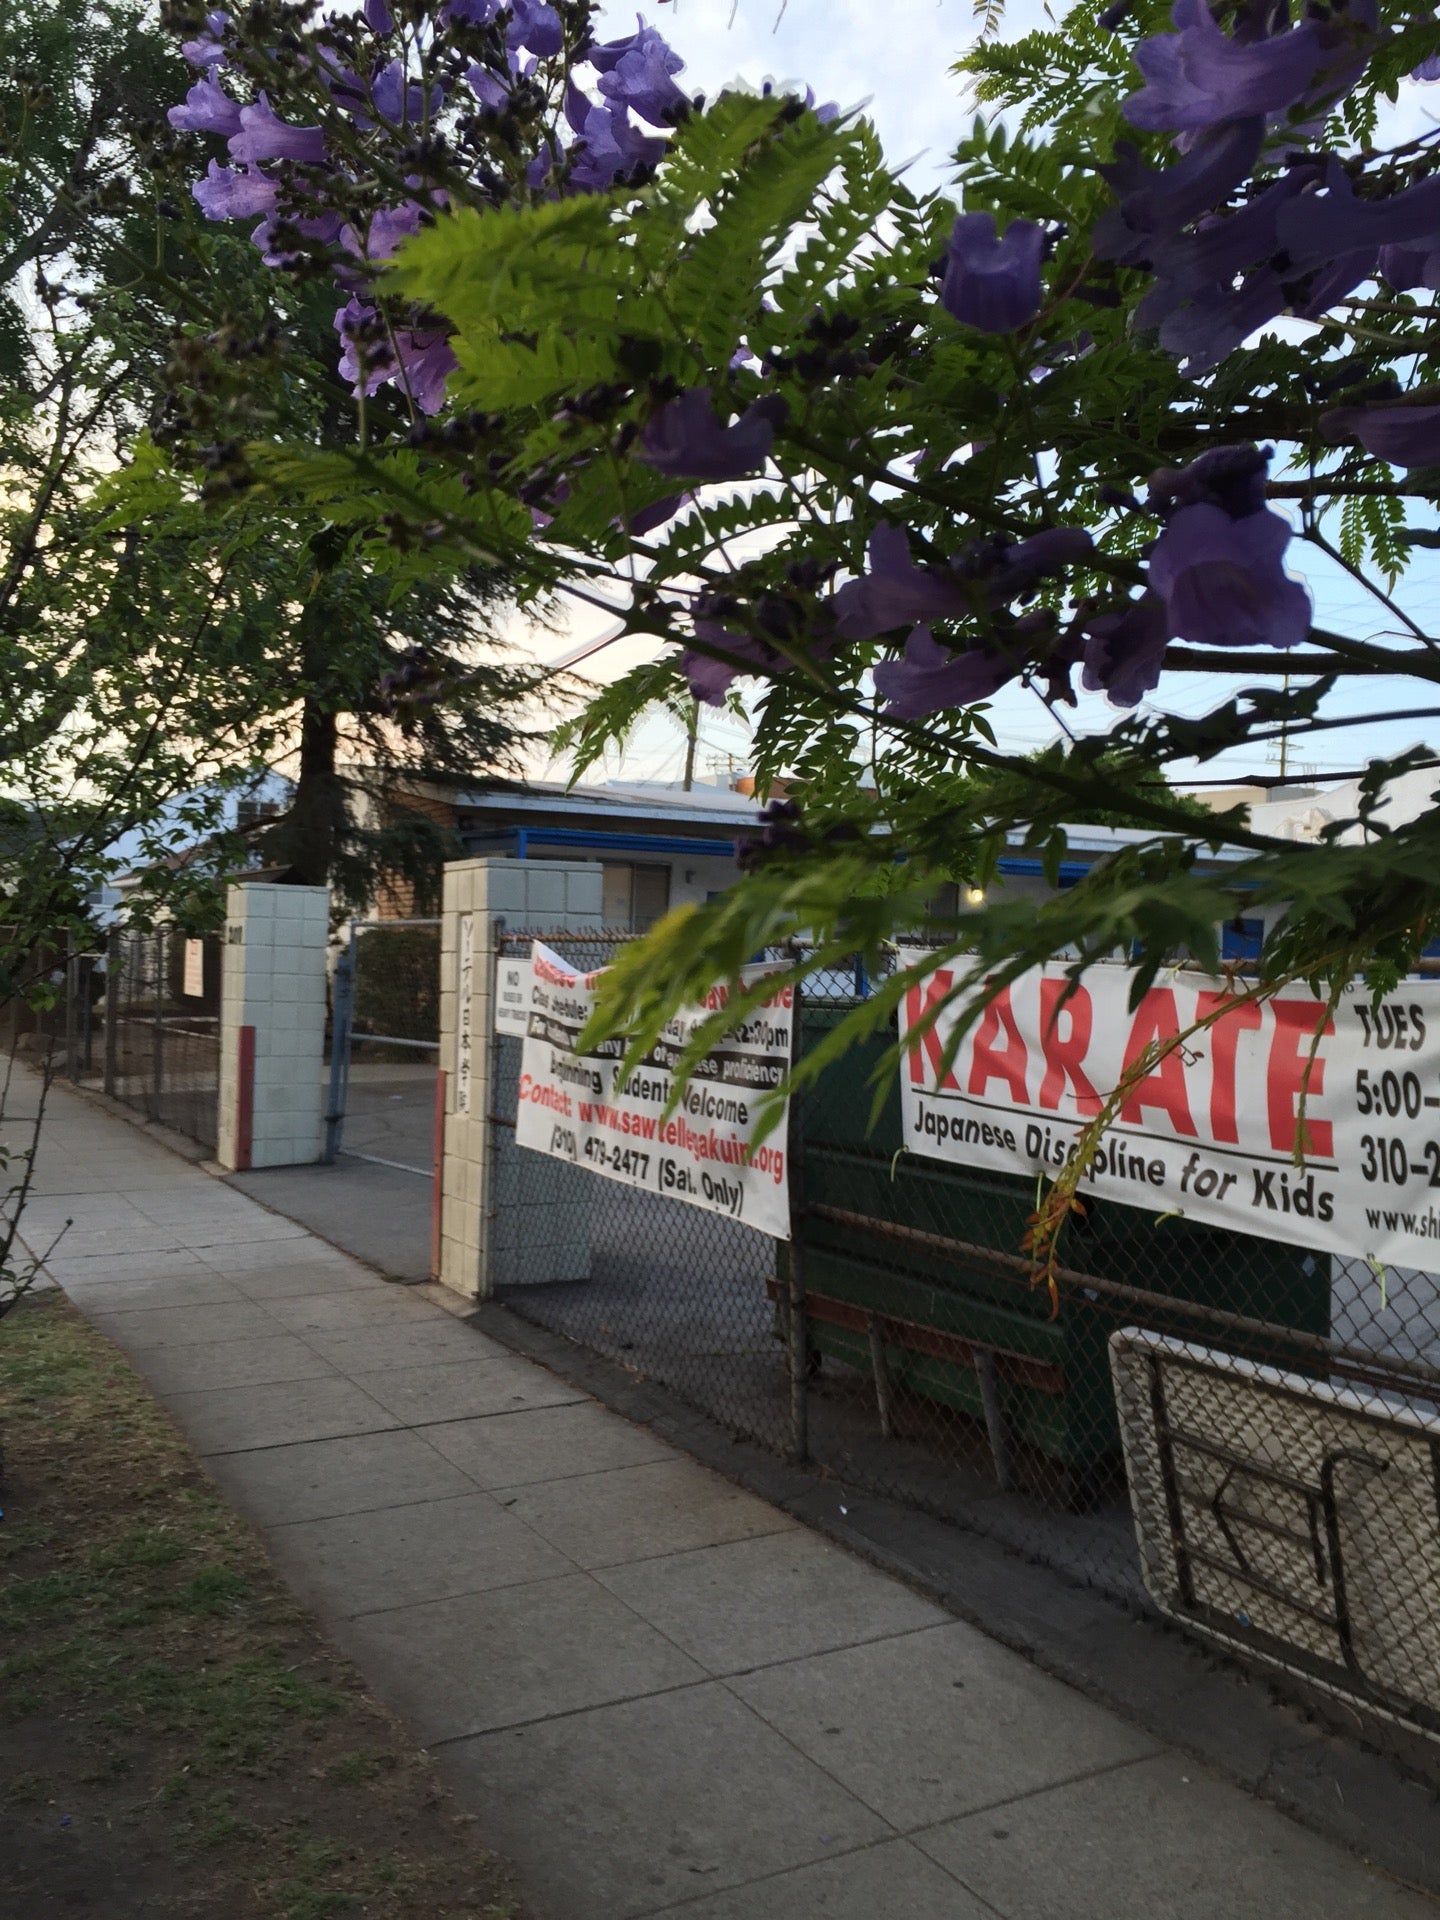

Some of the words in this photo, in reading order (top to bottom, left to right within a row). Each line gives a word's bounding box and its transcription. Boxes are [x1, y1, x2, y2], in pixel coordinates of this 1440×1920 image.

[1353, 1003, 1427, 1052] TUES
[613, 1065, 674, 1104] Sudent
[722, 1057, 784, 1087] proficiency
[905, 964, 1336, 1159] KARATE
[584, 1136, 650, 1180] 479-2477
[657, 1157, 697, 1194] (Sat.
[701, 1172, 744, 1218] Only)
[914, 1101, 1017, 1153] Japanese
[1025, 1124, 1166, 1187] Discpline
[1180, 1152, 1237, 1200] for
[1252, 1168, 1335, 1223] Kids
